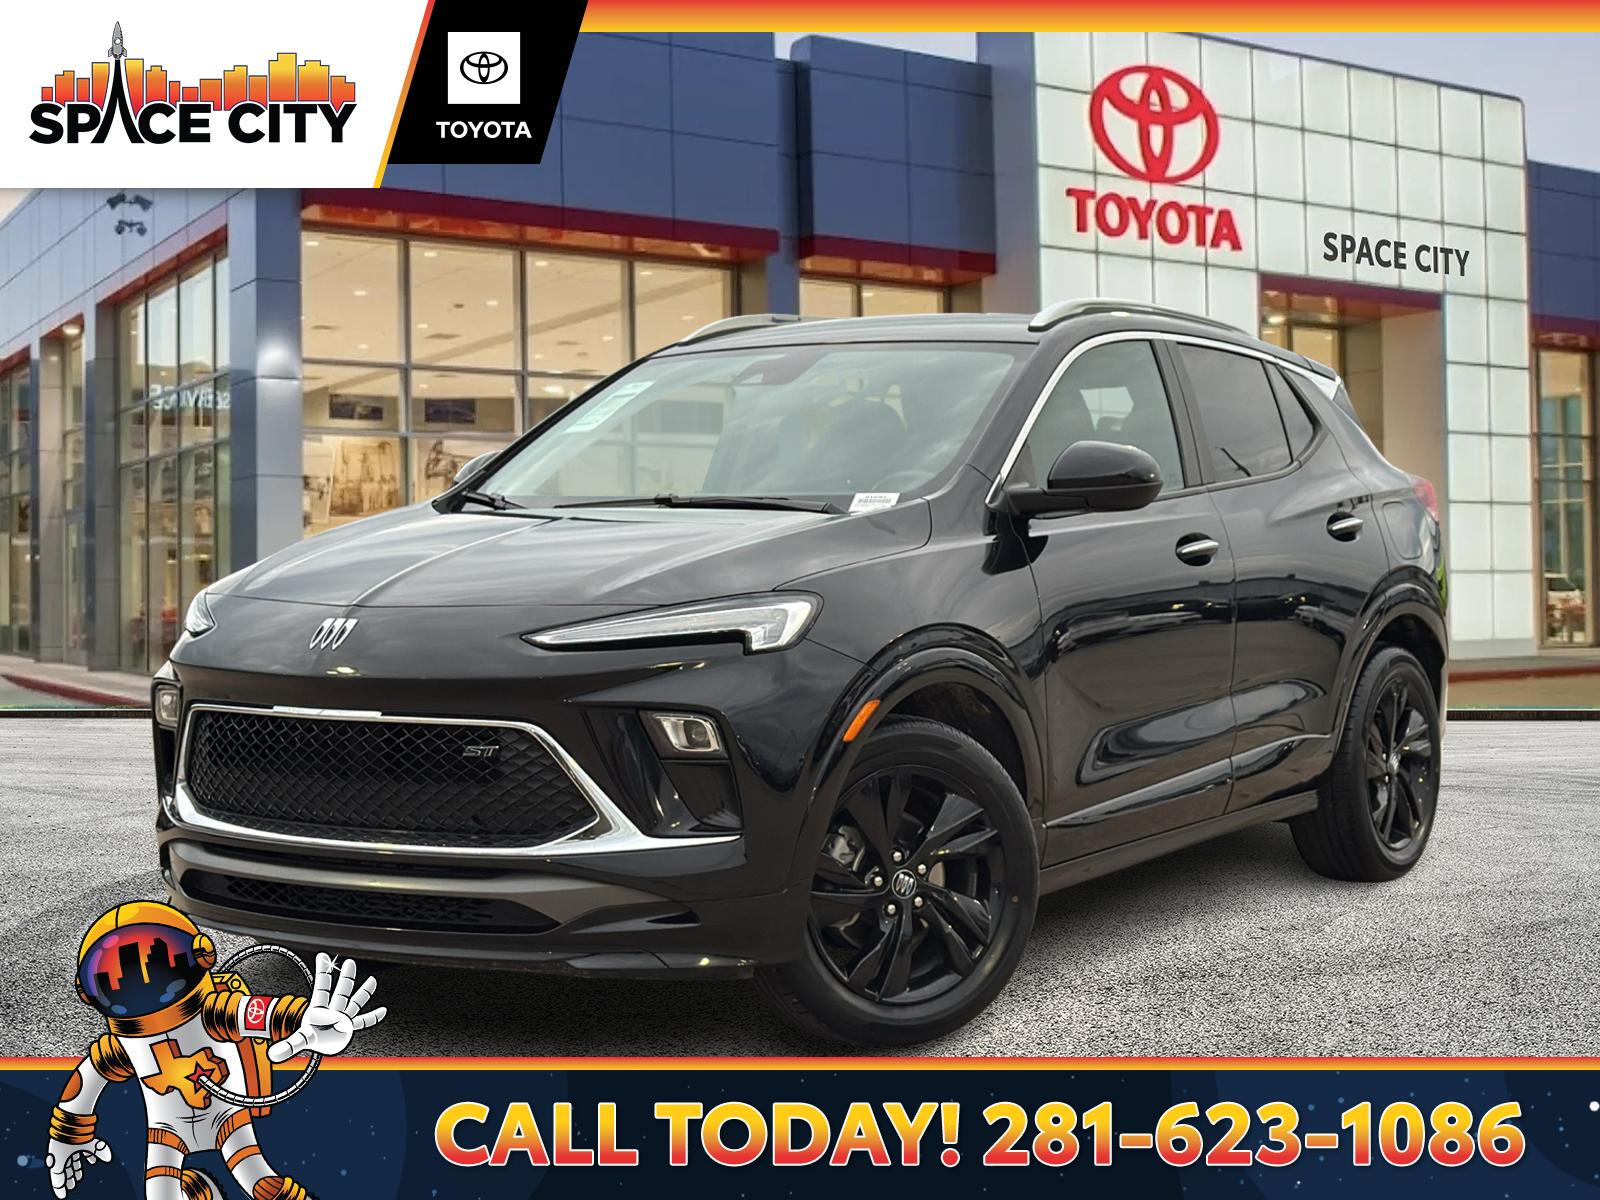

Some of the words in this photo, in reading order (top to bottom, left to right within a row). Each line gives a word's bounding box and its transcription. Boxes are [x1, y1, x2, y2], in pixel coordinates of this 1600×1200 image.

[1066, 187, 1243, 251] TOYOTA
[1322, 231, 1407, 270] SPACE
[1414, 244, 1470, 277] CITY
[462, 745, 500, 757] ST
